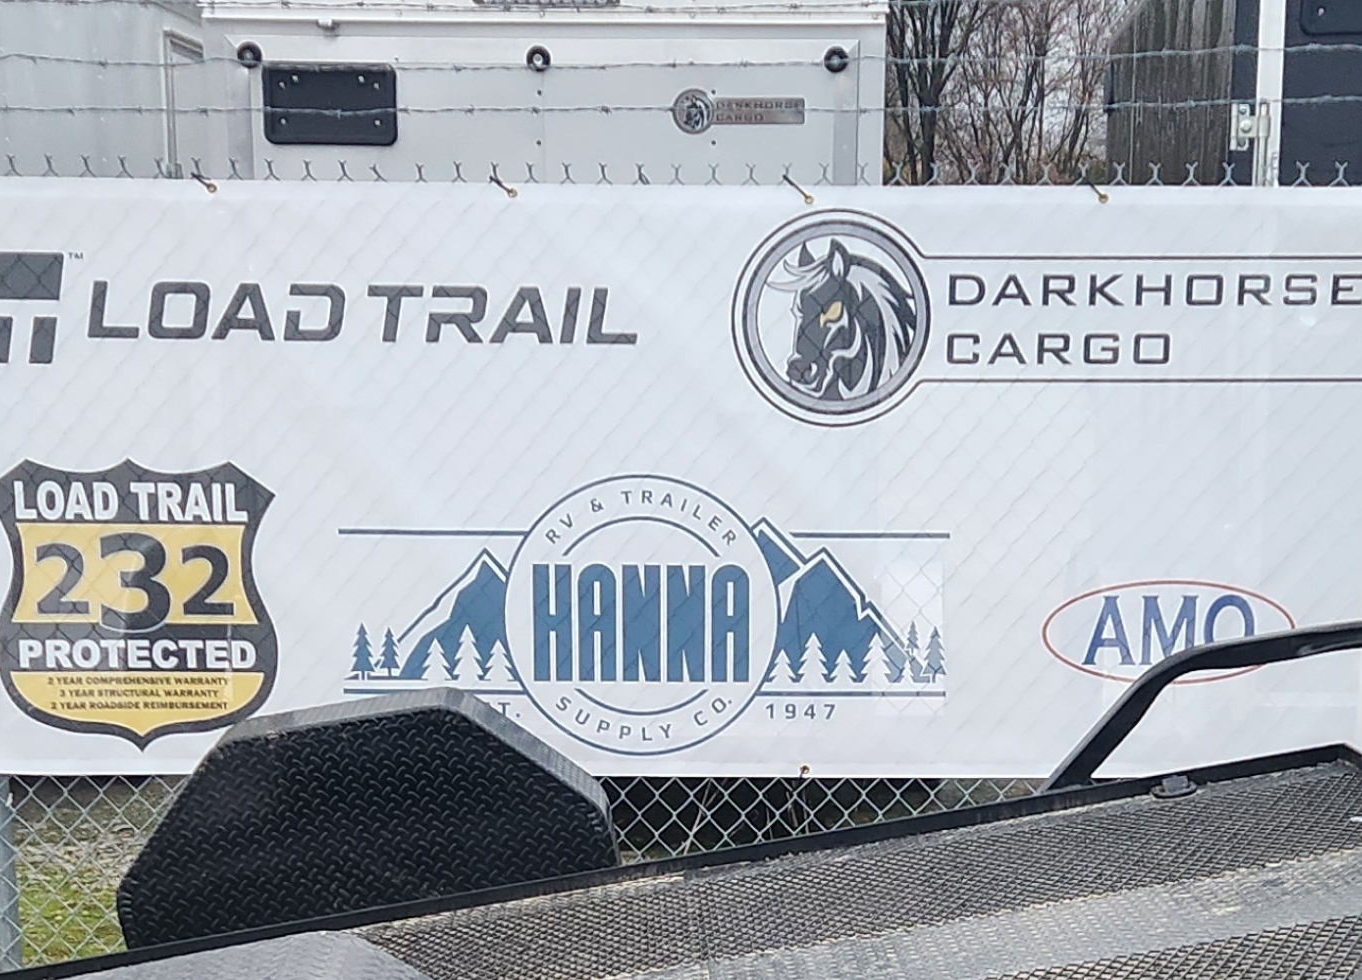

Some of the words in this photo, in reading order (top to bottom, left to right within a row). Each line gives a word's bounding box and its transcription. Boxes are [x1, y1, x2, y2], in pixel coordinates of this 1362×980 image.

[87, 280, 347, 342] LOAD
[368, 285, 638, 345] TRAIL
[945, 332, 1172, 366] CARGO
[13, 480, 119, 522] LOAD
[136, 482, 249, 523] TRAIL
[545, 514, 575, 545] RV
[621, 490, 737, 546] TRAILER
[35, 532, 235, 632] 232
[532, 563, 750, 683] HANNA
[18, 638, 257, 670] PROTECTED
[56, 677, 83, 685] YEAR
[86, 677, 172, 685] COMPREHENSIVE
[174, 677, 230, 686] WARRANTY
[68, 689, 95, 697] YEAR
[98, 689, 161, 697] STRUCTURAL
[164, 689, 219, 697] WARRANTY
[60, 701, 86, 709] YEAR
[143, 701, 228, 710] REIMBURSEMENT
[555, 696, 672, 741] SUPPLY
[765, 703, 836, 720] 1947
